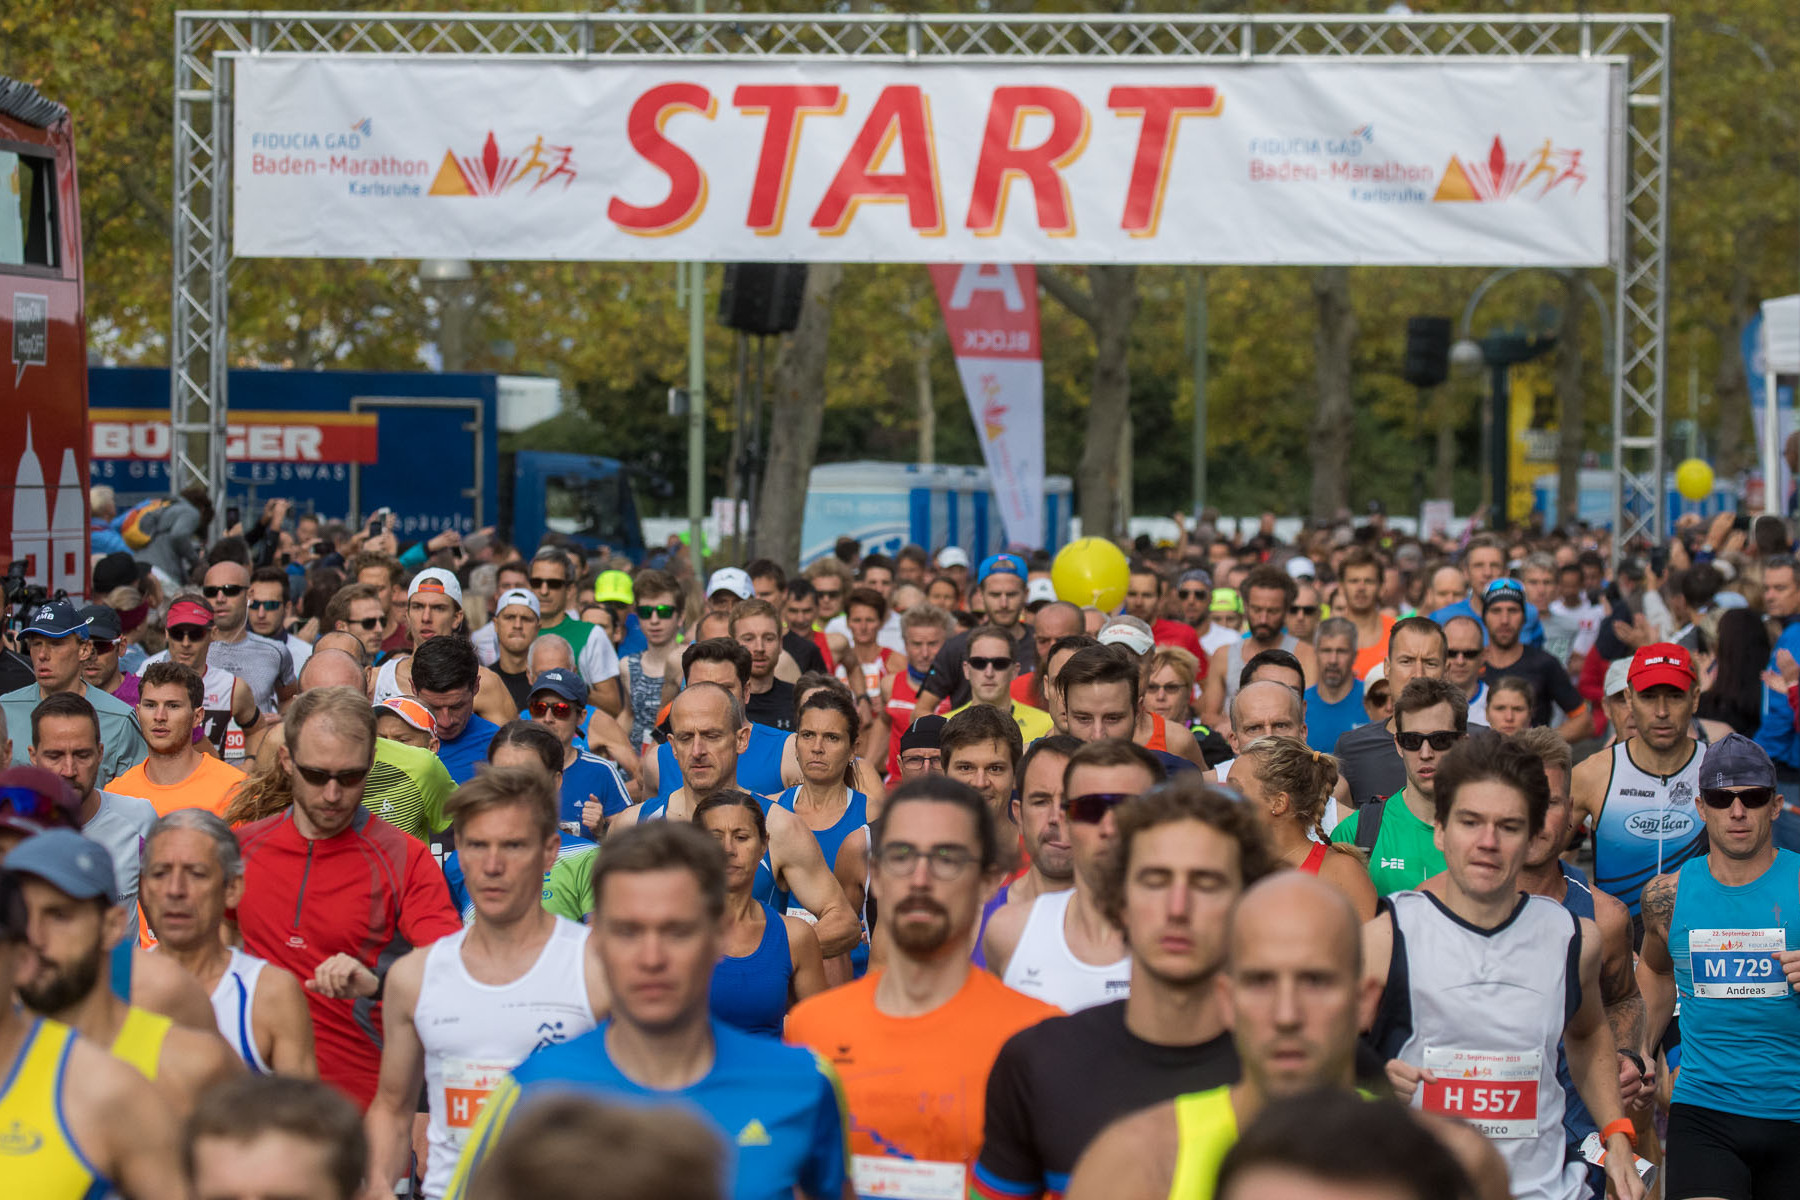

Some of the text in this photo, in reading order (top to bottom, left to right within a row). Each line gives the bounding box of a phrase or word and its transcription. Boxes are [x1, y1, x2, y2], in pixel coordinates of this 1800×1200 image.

[252, 132, 361, 150] FIDUCIA GAD
[252, 153, 429, 176] Baden-Marathon
[607, 82, 1223, 238] START
[1249, 160, 1433, 182] Baden-Marathon
[349, 181, 421, 197] Karlsruhe
[92, 420, 323, 460] BÜGER
[251, 463, 346, 481] ESSWAS
[1722, 930, 1750, 938] September
[1705, 958, 1772, 977] M 729
[1726, 986, 1766, 995] Andreas
[453, 1096, 469, 1121] H
[1444, 1086, 1521, 1113] H 557
